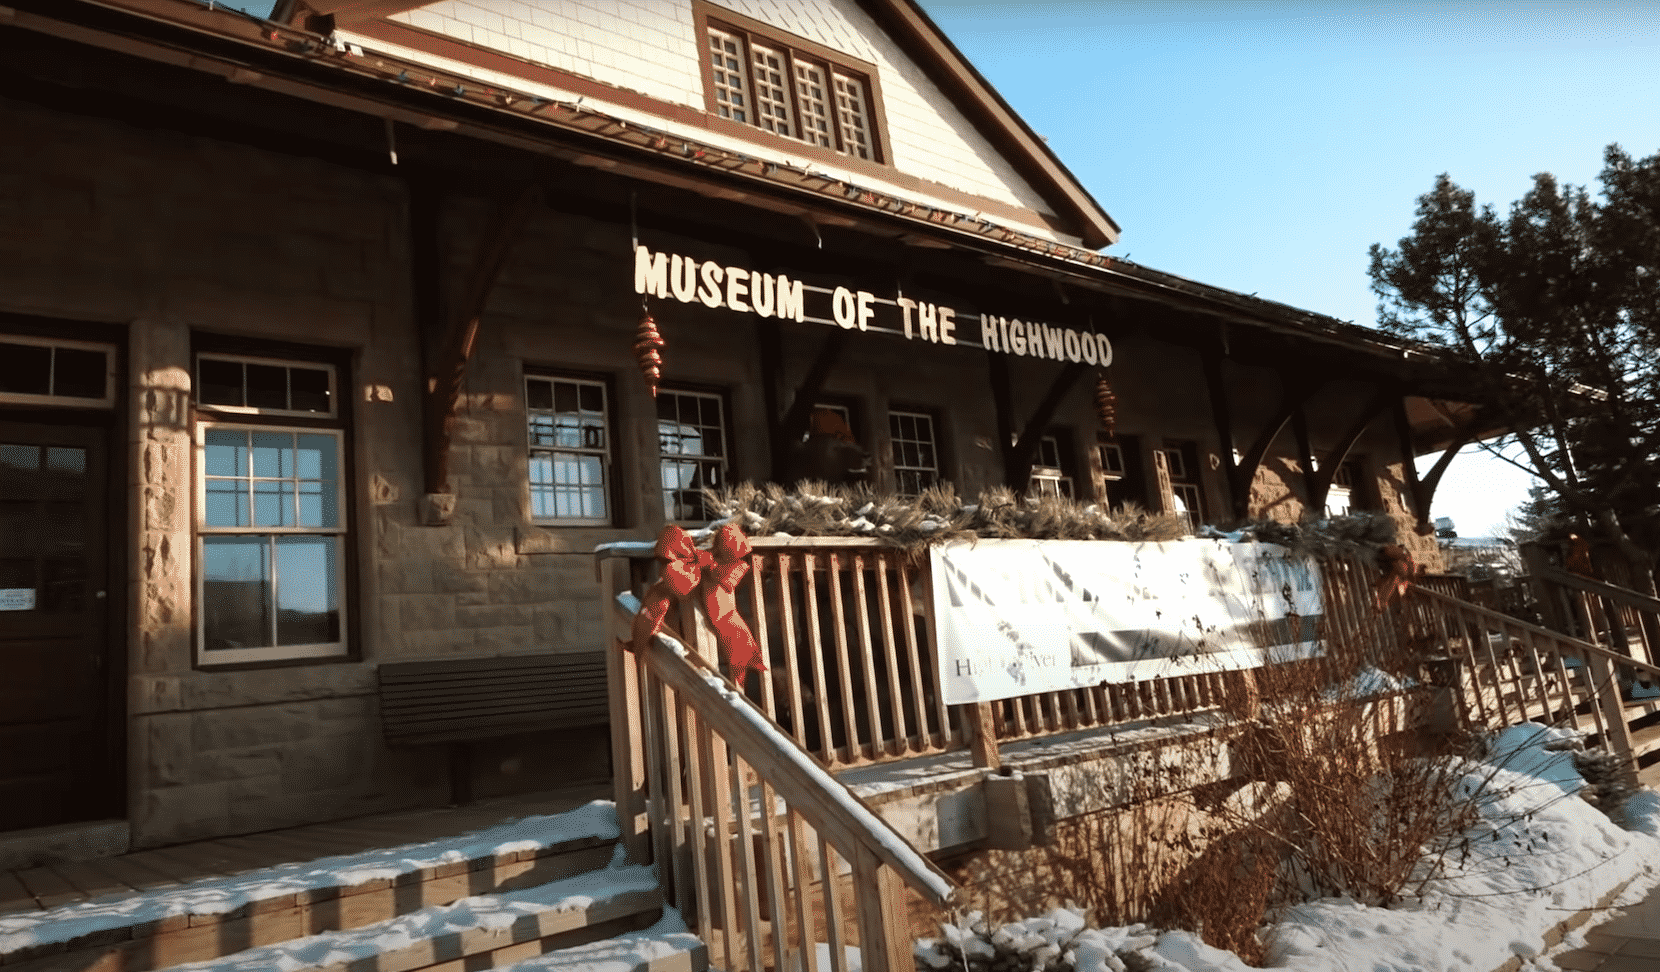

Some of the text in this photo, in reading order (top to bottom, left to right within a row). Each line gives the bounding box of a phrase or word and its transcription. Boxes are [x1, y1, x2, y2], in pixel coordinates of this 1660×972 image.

[634, 245, 1113, 367] MUSEUM OF THE HIGHWOOD
